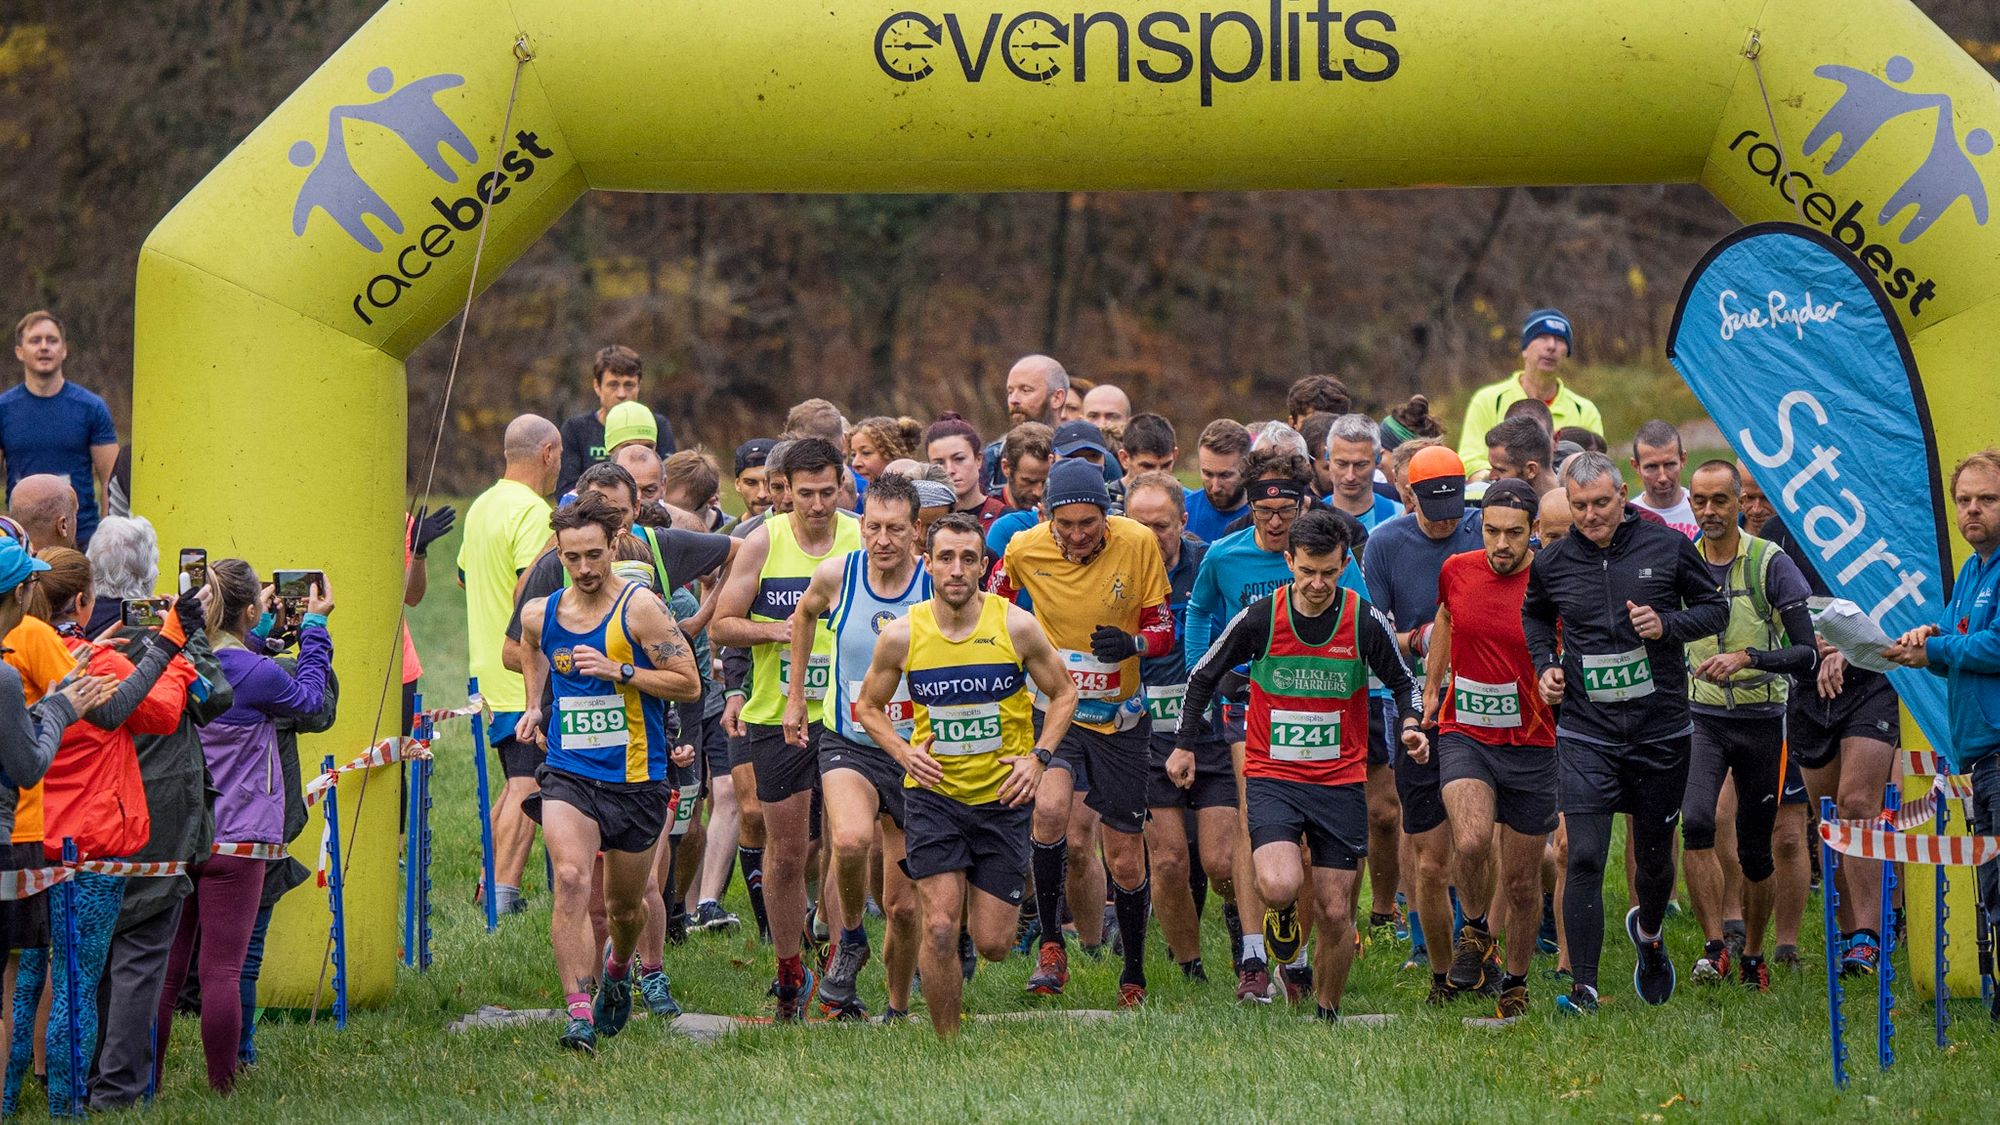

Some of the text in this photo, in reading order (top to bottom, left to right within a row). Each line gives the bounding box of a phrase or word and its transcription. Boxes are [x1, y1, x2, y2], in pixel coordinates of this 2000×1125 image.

[874, 0, 1400, 107] evensplits
[352, 129, 554, 326] racebest
[1728, 130, 1937, 317] racebest
[1719, 289, 1843, 340] Sue Ryder
[1739, 390, 1927, 638] Start
[766, 590, 804, 606] SKIP
[914, 676, 1014, 697] SKIPTON AC
[1295, 668, 1347, 682] ILKLEY
[1295, 680, 1347, 692] HARRIERS
[1586, 661, 1650, 689] 1414
[1150, 699, 1180, 718] 14
[1457, 692, 1517, 714] 1528
[562, 709, 624, 733] 1589
[933, 717, 1000, 741] 1045
[1274, 725, 1336, 746] 1241
